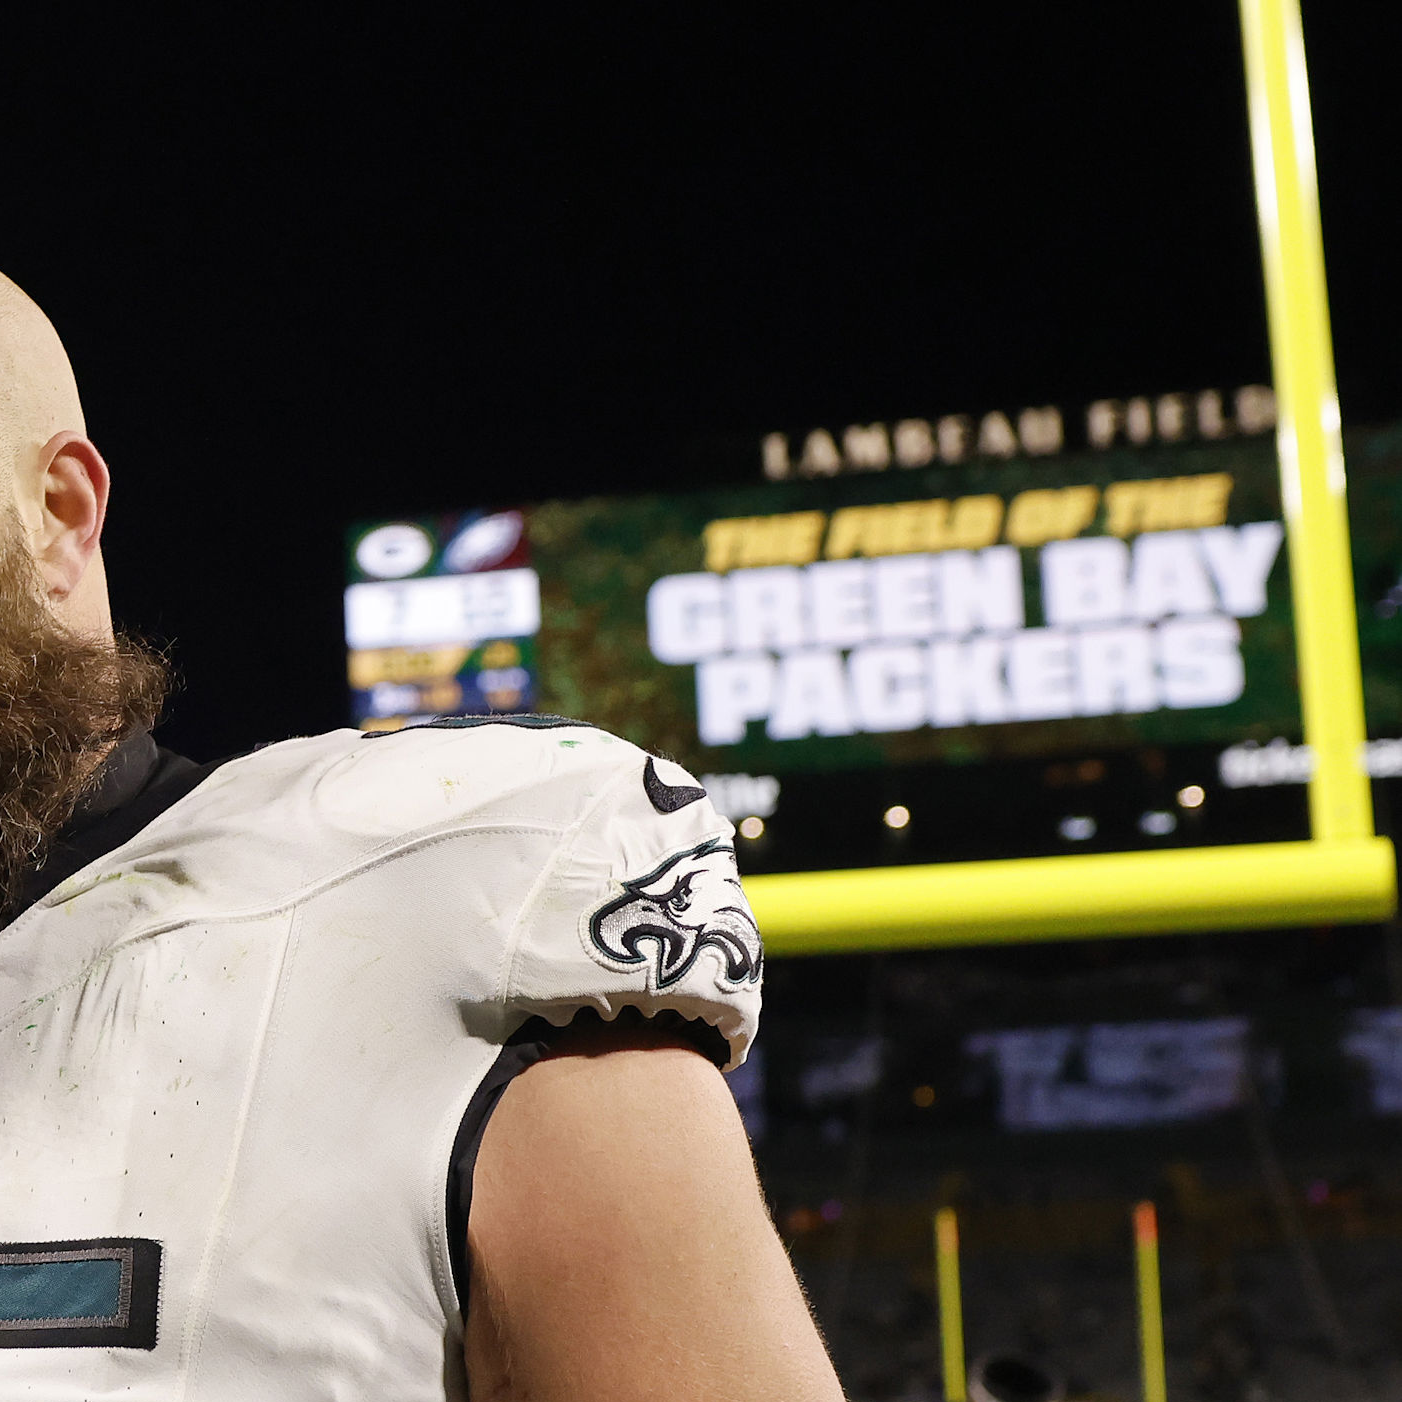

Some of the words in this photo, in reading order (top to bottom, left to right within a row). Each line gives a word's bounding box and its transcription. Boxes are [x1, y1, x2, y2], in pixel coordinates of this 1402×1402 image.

[761, 405, 1064, 481] LAMBEAU
[1086, 384, 1279, 449] FIELD
[648, 546, 1024, 664] GREEN
[1041, 520, 1283, 628] BAY
[698, 615, 1244, 746] PACKERS
